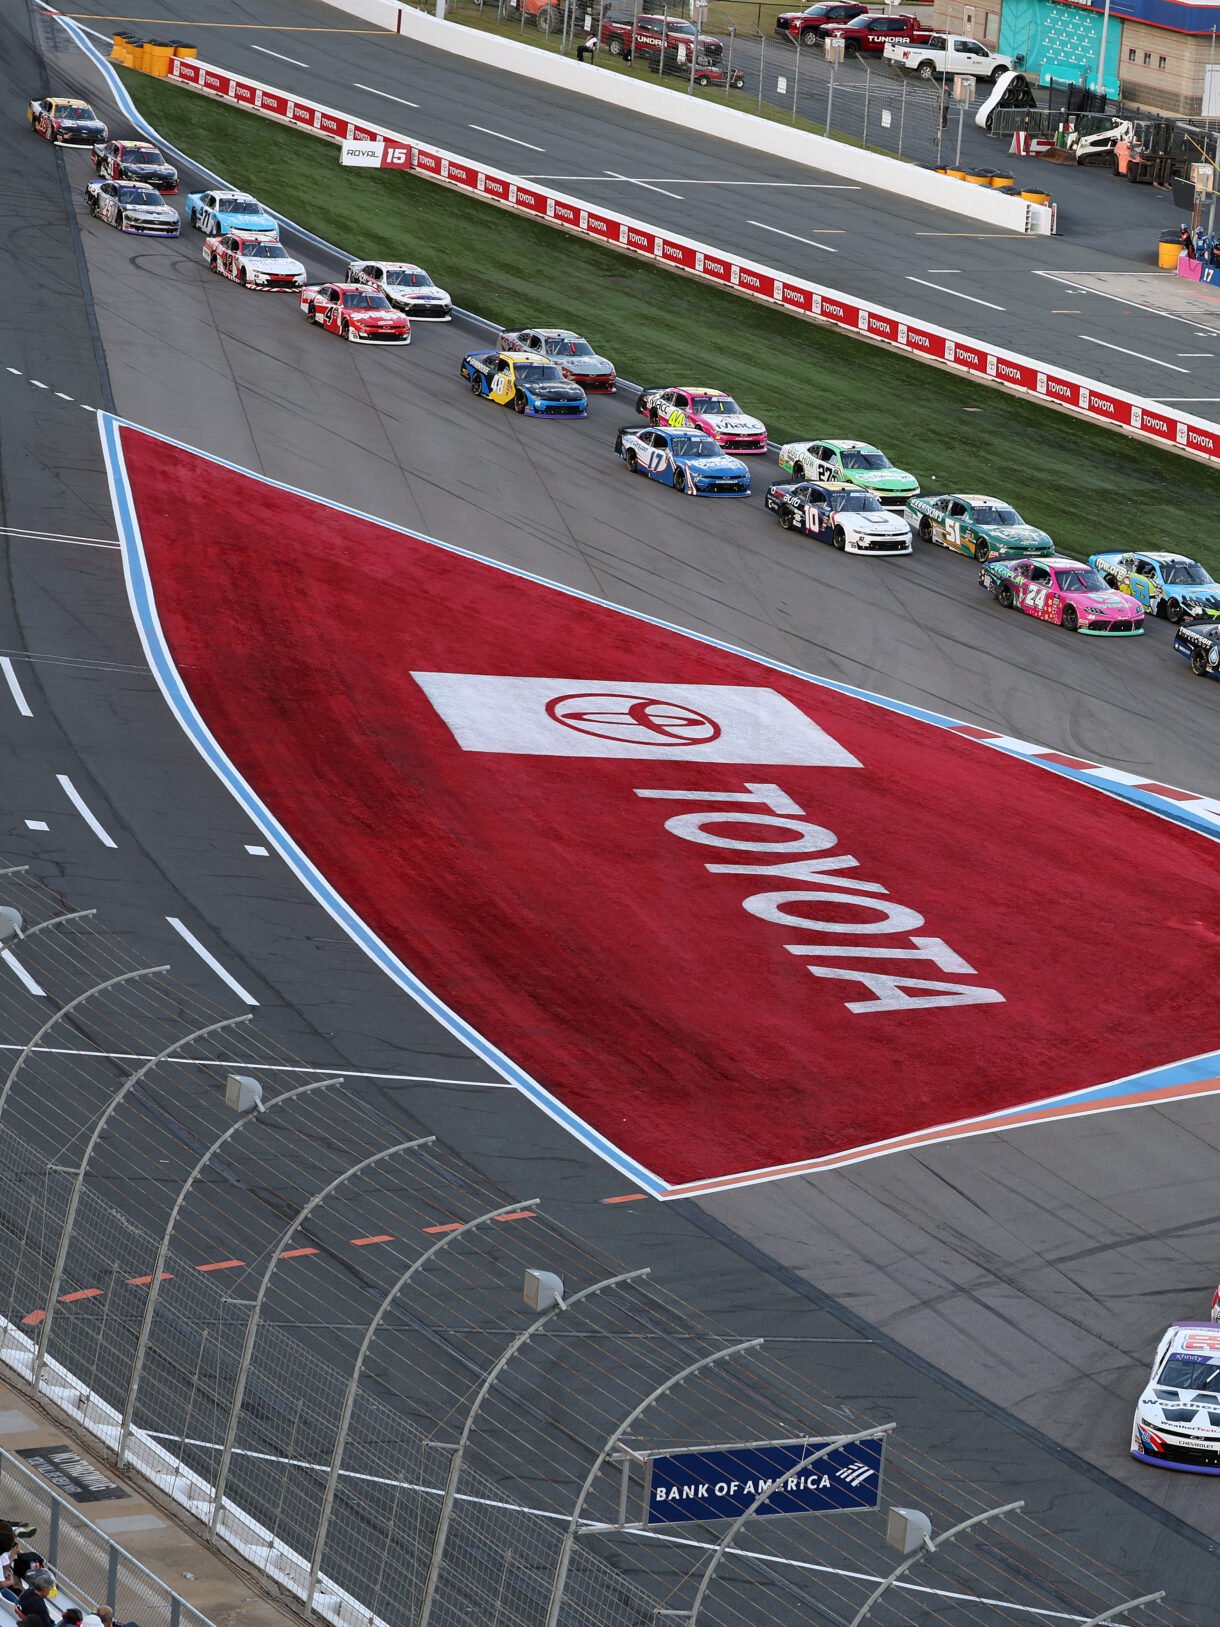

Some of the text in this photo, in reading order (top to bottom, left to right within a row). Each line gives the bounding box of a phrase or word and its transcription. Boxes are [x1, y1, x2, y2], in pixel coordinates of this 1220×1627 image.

[868, 35, 910, 44] TUNDRA
[386, 148, 407, 164] 15
[740, 272, 760, 288] TOYOTA
[1204, 268, 1214, 282] 17
[784, 288, 804, 304] TOYOTA
[324, 306, 334, 326] 4
[822, 302, 844, 318] TOYOTA
[869, 318, 890, 334] TOYOTA
[908, 332, 930, 348] TOYOTA
[956, 348, 978, 365] TOYOTA
[998, 364, 1020, 381] TOYOTA
[490, 374, 505, 394] 48
[1048, 380, 1071, 398] TOYOTA
[1090, 396, 1114, 414] TOYOTA
[668, 410, 684, 427] 44
[1142, 414, 1168, 432] TOYOTA
[1188, 432, 1213, 450] TOYOTA
[650, 451, 664, 472] 17
[818, 464, 832, 482] 27
[804, 505, 818, 533] 10
[945, 518, 961, 544] 51
[1025, 585, 1046, 612] 24
[633, 783, 1007, 1014] TOYOTA
[1175, 1354, 1203, 1362] xfinity
[1179, 1441, 1214, 1449] CHEVROLET
[656, 1483, 709, 1501] BANK
[714, 1482, 739, 1496] OF
